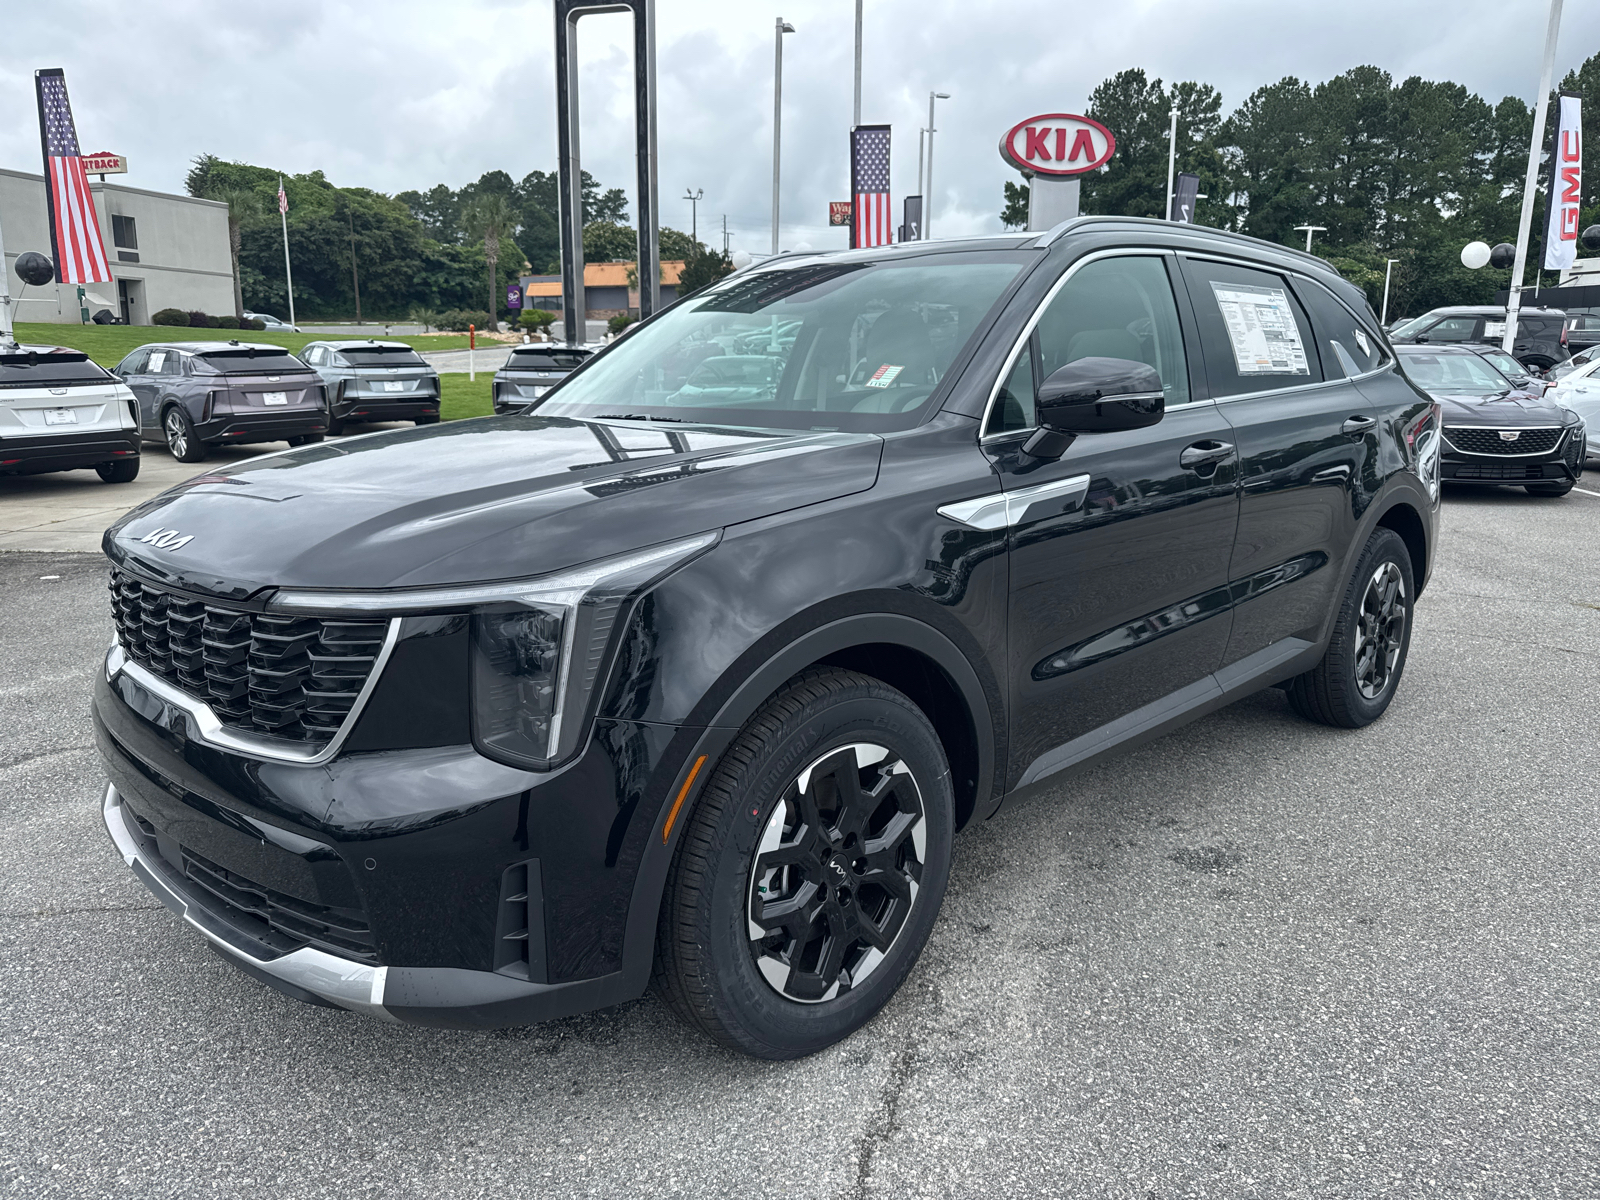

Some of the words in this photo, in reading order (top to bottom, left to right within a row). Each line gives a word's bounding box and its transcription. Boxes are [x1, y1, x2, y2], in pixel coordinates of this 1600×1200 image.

[1025, 126, 1097, 162] KIA
[82, 158, 120, 170] UTBACK
[1560, 130, 1580, 241] GMC
[831, 202, 852, 214] Wag
[141, 526, 195, 552] KIA
[742, 730, 809, 824] Continental
